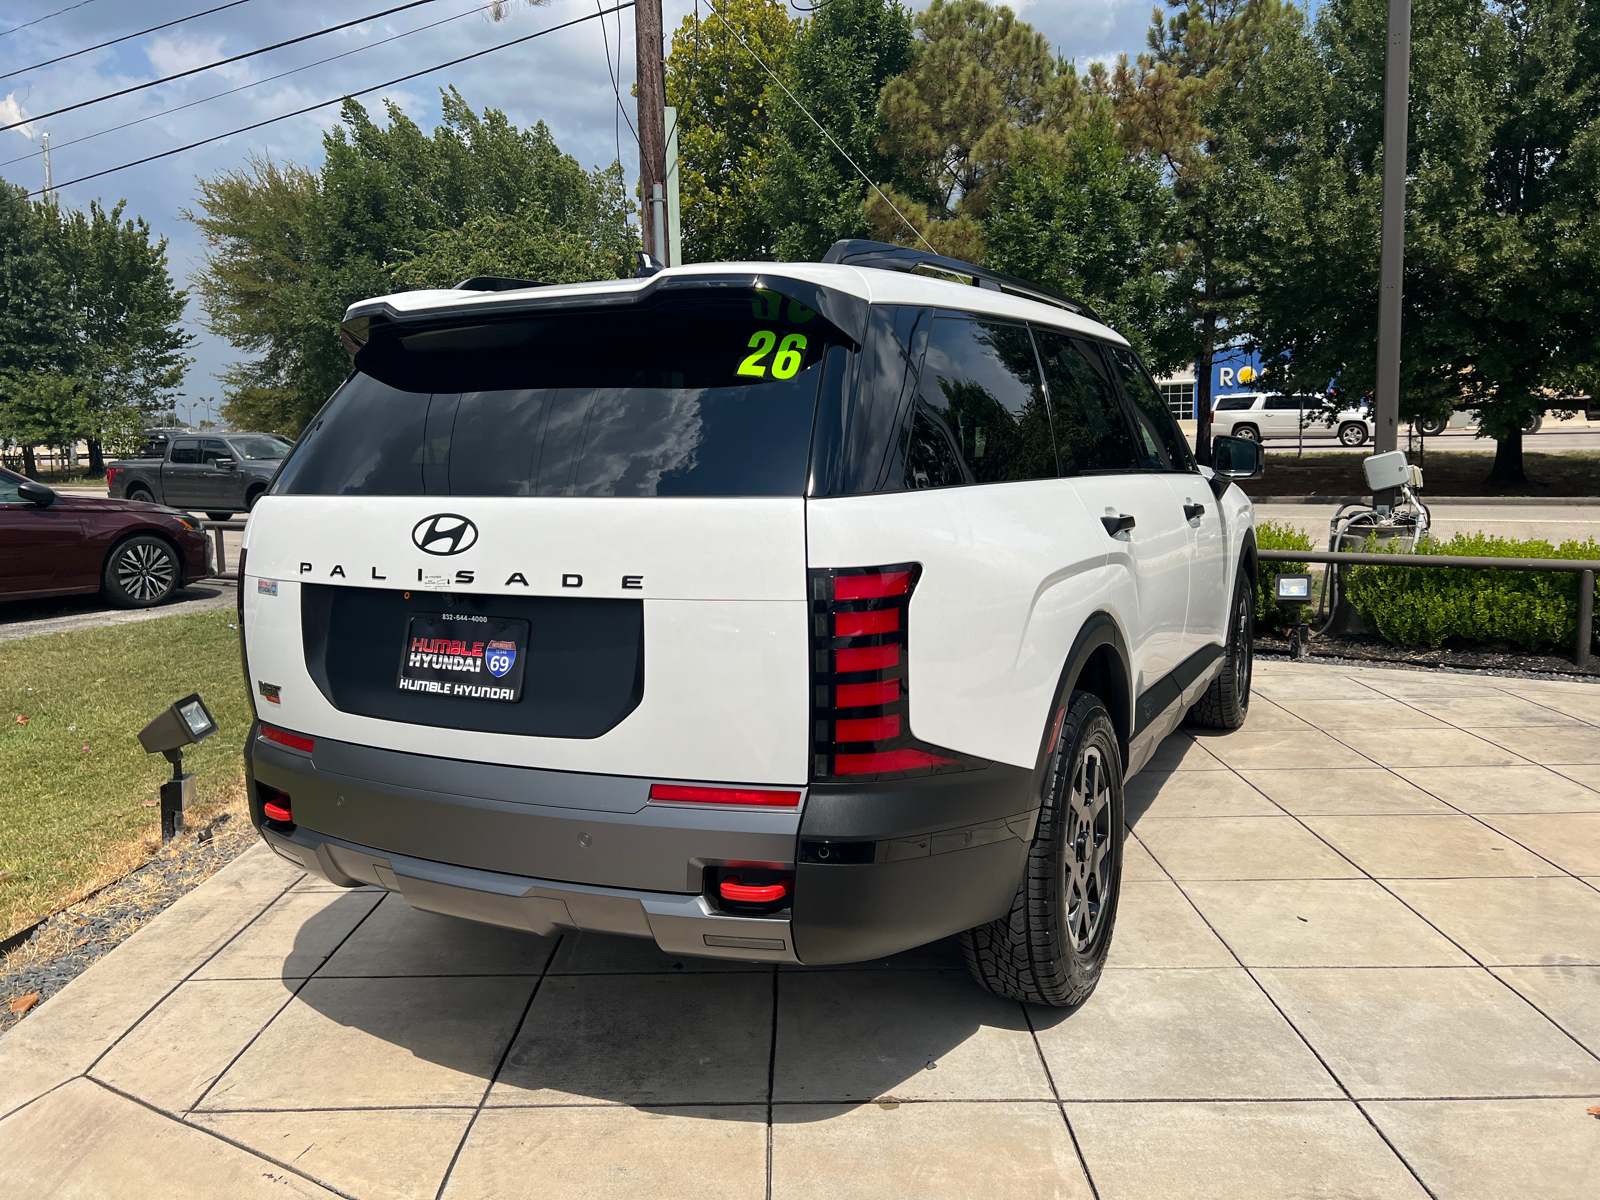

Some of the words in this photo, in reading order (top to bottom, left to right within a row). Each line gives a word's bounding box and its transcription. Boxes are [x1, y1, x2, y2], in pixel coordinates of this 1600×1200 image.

[737, 330, 807, 379] 26
[300, 562, 644, 590] PALISADE
[442, 613, 487, 623] 832-644-4000
[411, 637, 484, 657] HUMBLE
[409, 652, 481, 673] HYUNDAI
[490, 655, 509, 672] 69
[399, 678, 451, 694] HUMBLE
[453, 684, 514, 700] HYUNDAI
